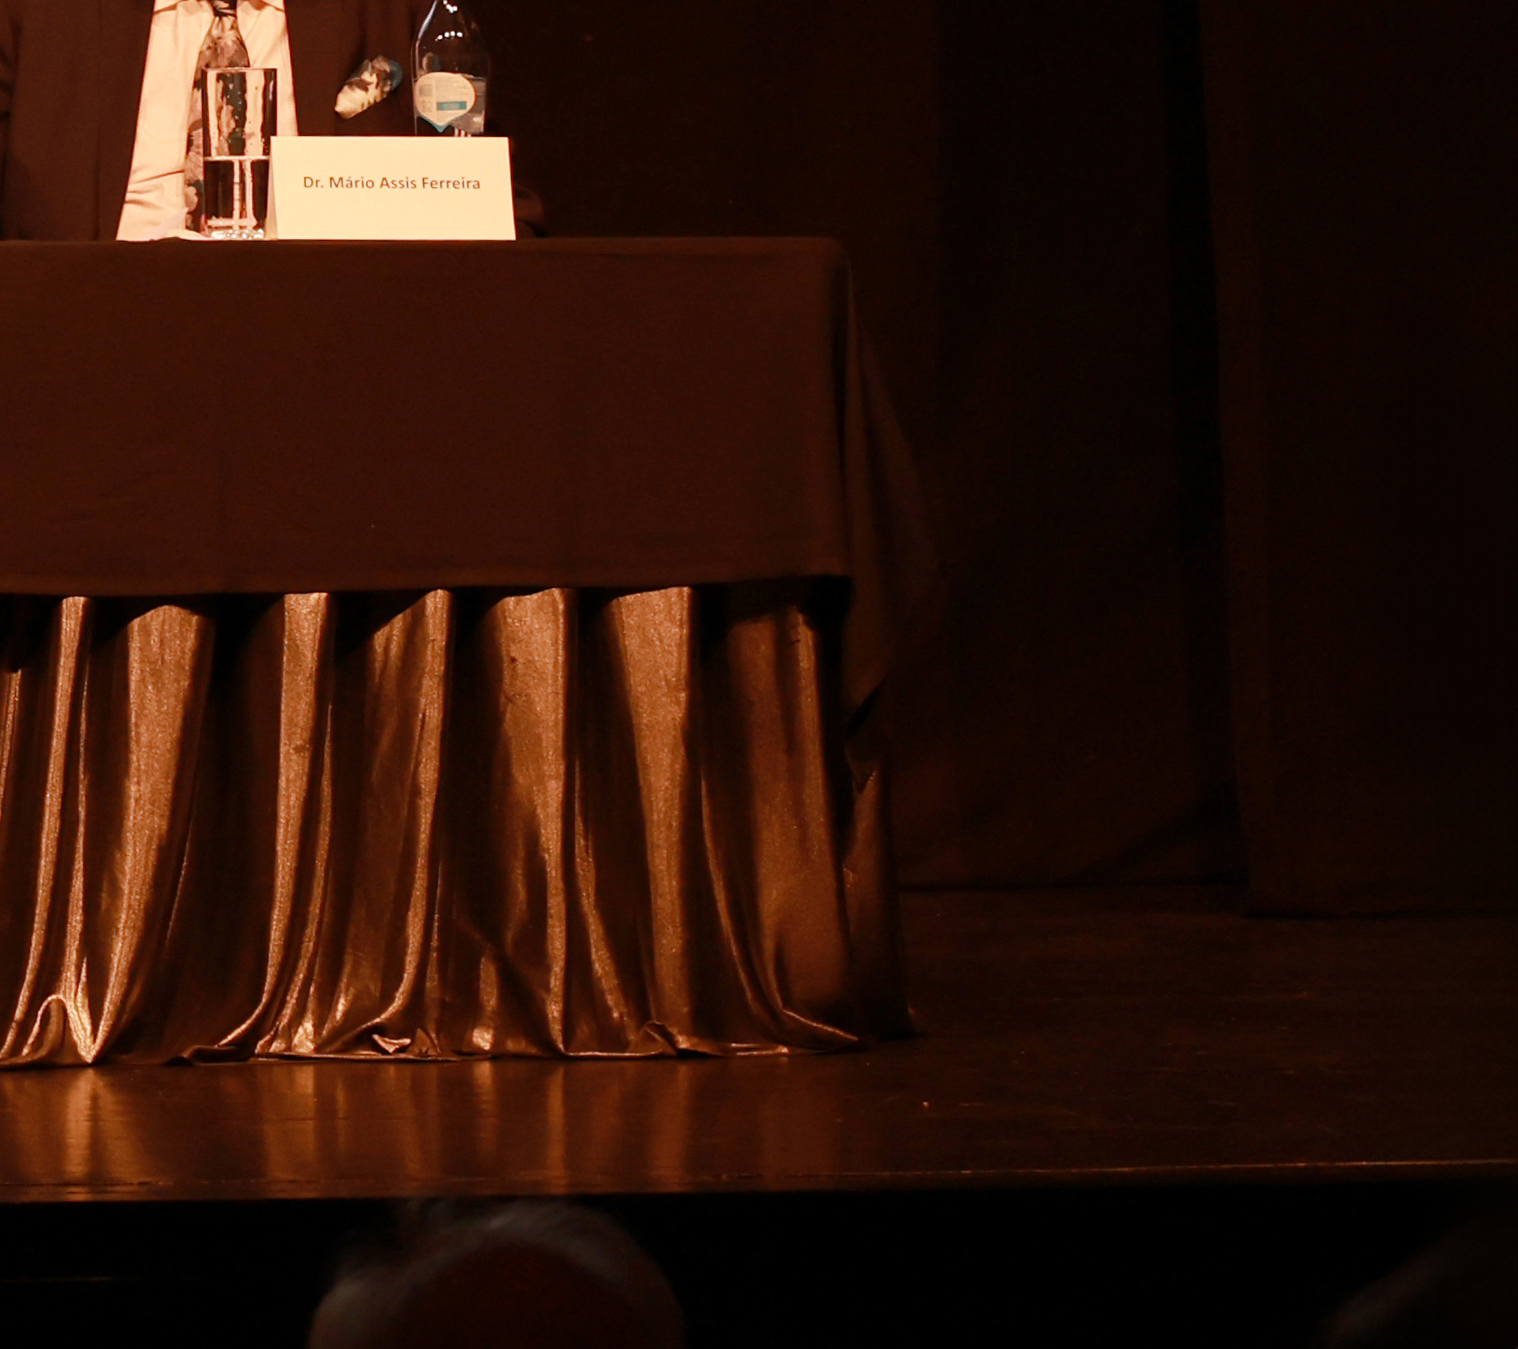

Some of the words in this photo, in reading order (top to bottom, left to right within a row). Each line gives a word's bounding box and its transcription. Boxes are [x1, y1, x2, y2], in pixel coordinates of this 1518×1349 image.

[303, 176, 324, 189] Dr.
[329, 175, 375, 189] Mário
[379, 176, 417, 189] Assis
[422, 176, 480, 190] Ferreira
